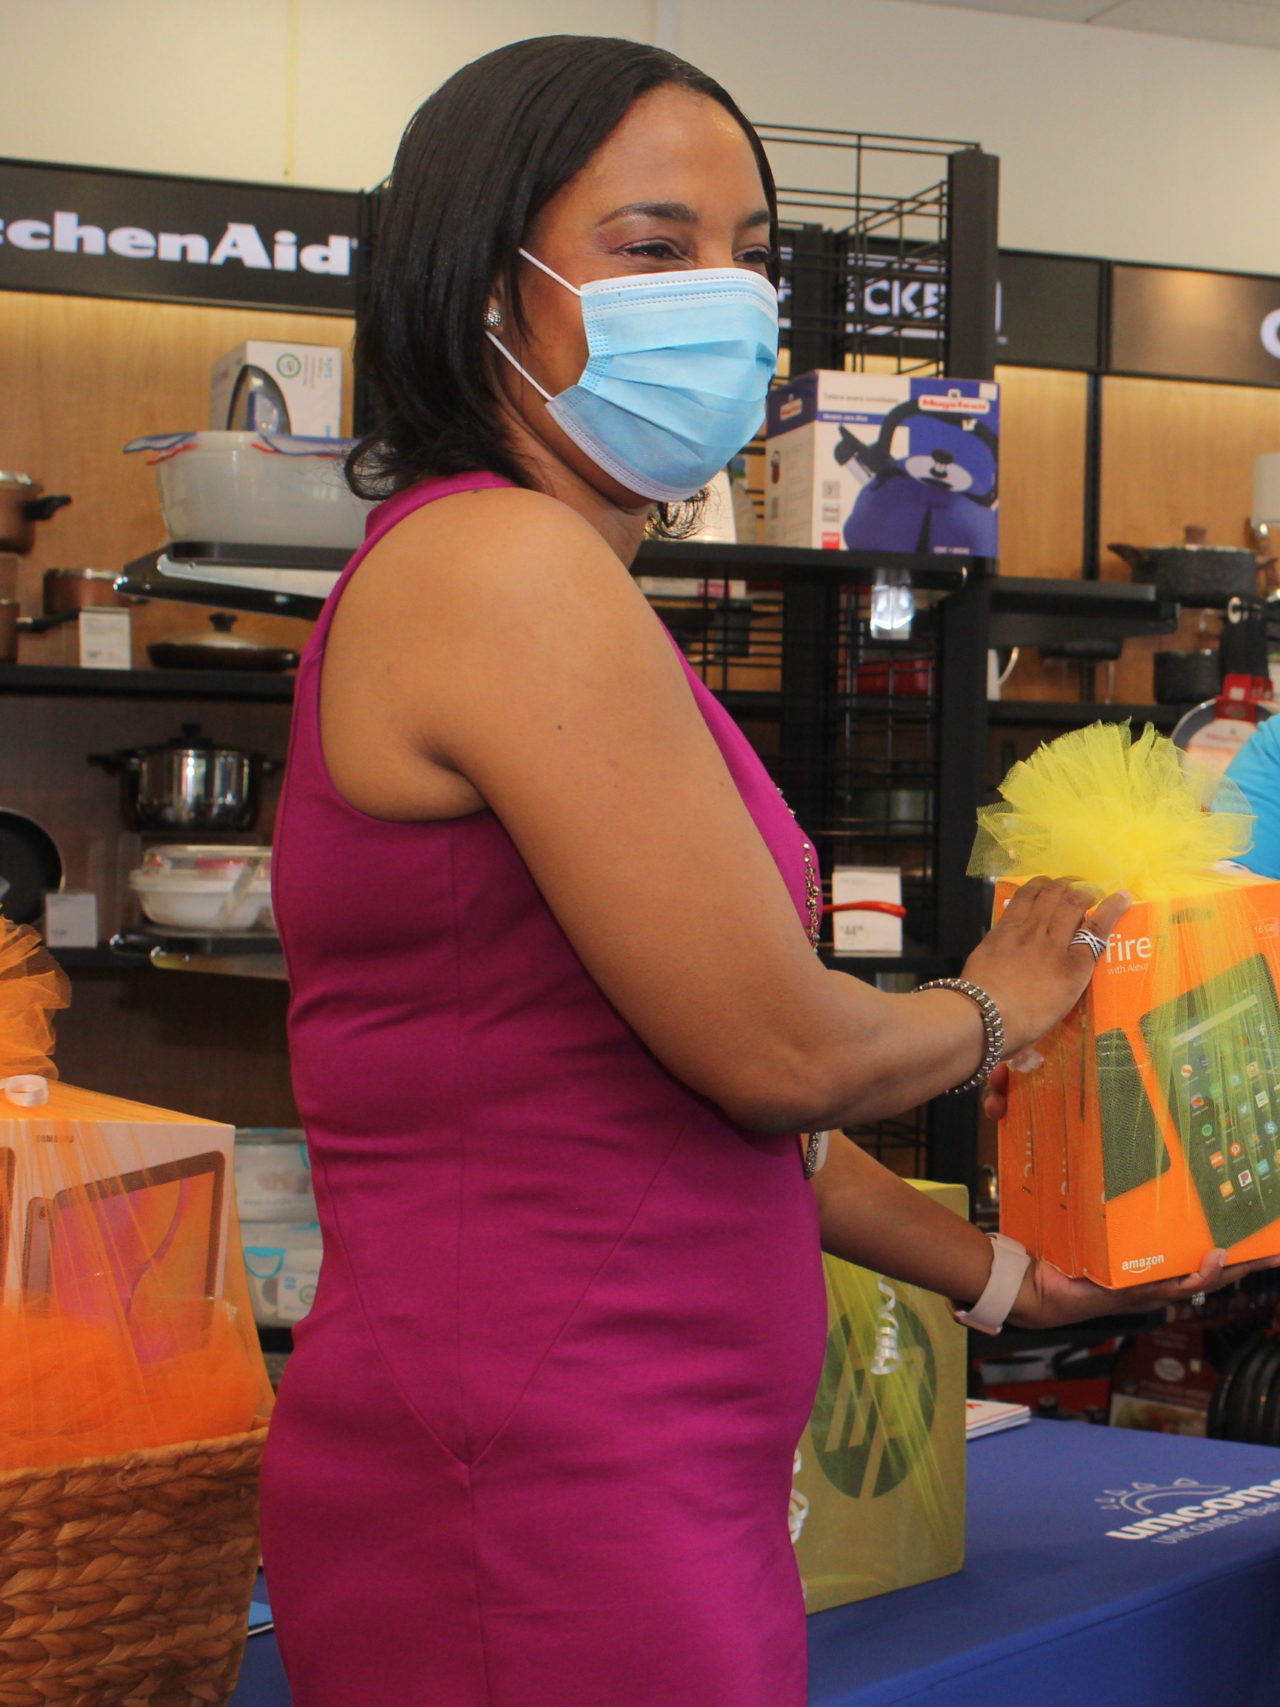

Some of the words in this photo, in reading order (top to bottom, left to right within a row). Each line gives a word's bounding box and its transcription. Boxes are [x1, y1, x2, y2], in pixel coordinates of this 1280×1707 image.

[0, 211, 350, 276] chenAid
[1105, 933, 1152, 963] fire
[1107, 965, 1127, 975] with
[1122, 1254, 1165, 1271] amazon
